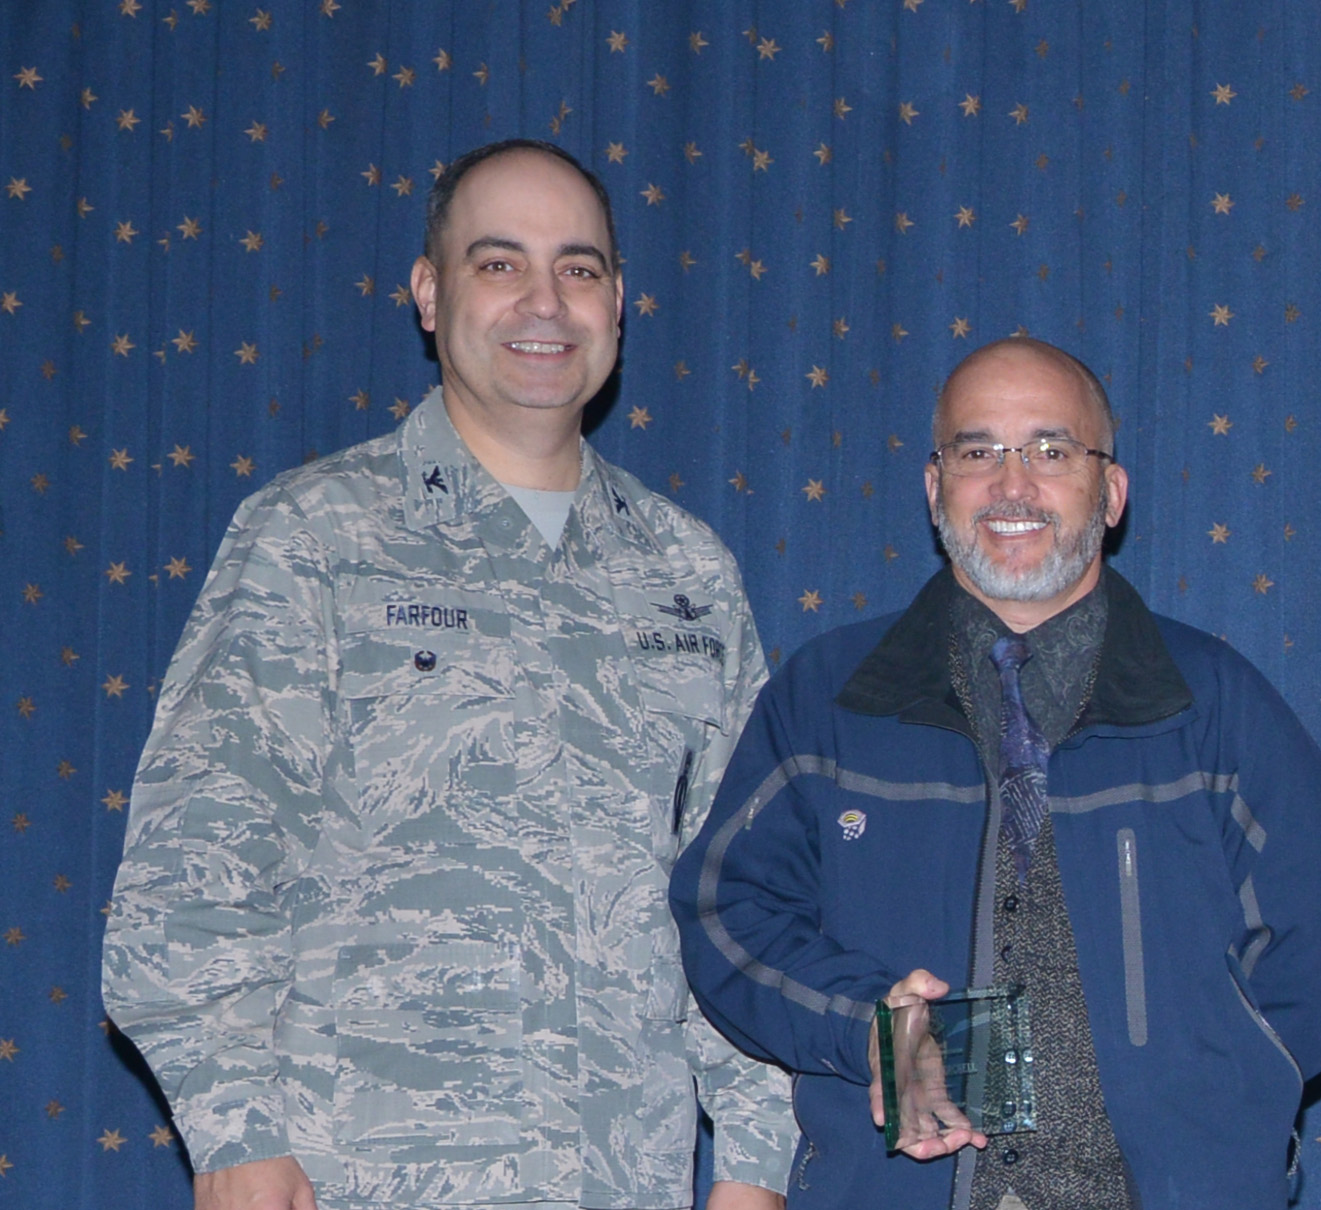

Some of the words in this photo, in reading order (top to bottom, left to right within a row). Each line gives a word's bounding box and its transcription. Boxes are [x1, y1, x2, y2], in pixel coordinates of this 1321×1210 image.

[386, 604, 468, 630] FARFOUR
[636, 631, 672, 652] U.S.
[675, 633, 701, 654] AIR
